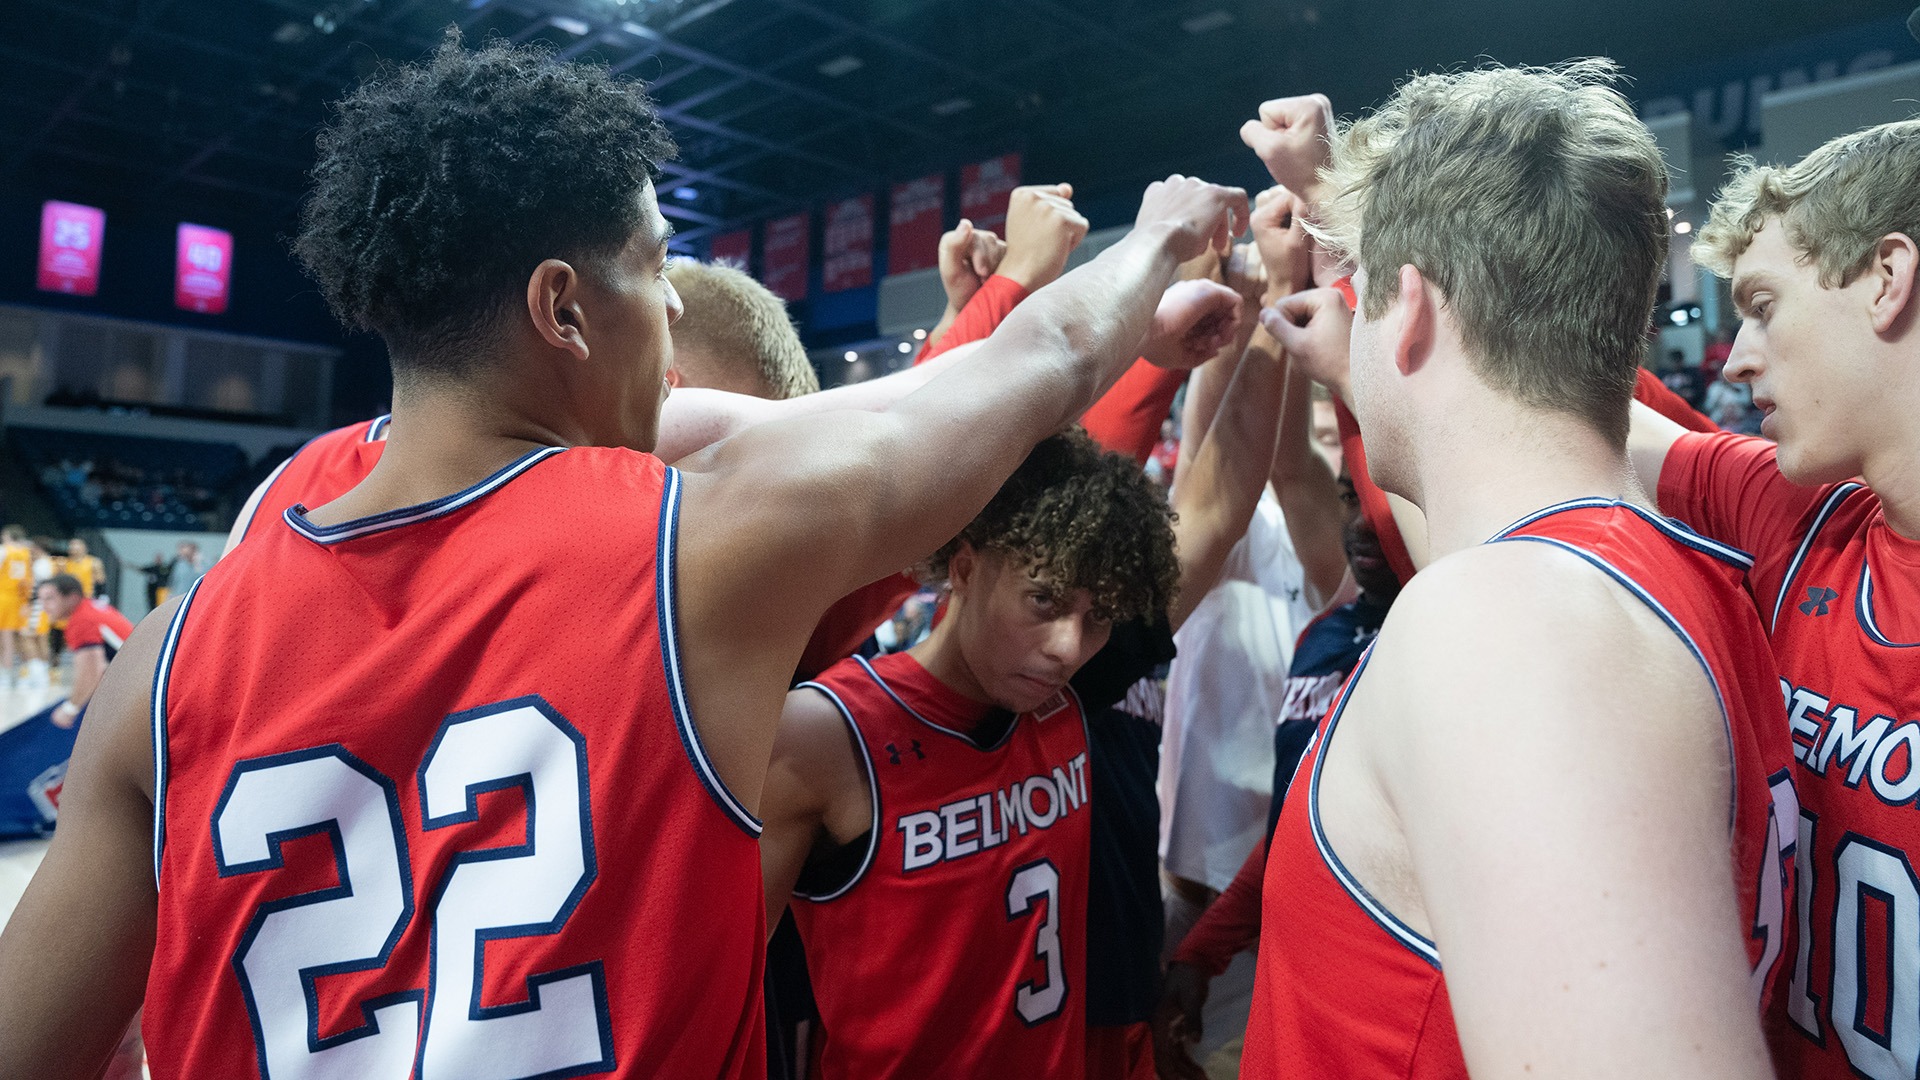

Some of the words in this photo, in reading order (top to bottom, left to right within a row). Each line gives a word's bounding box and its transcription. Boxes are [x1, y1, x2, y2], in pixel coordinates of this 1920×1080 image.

[210, 693, 617, 1080] 22
[897, 751, 1089, 873] BELMONT
[1005, 857, 1070, 1028] 3
